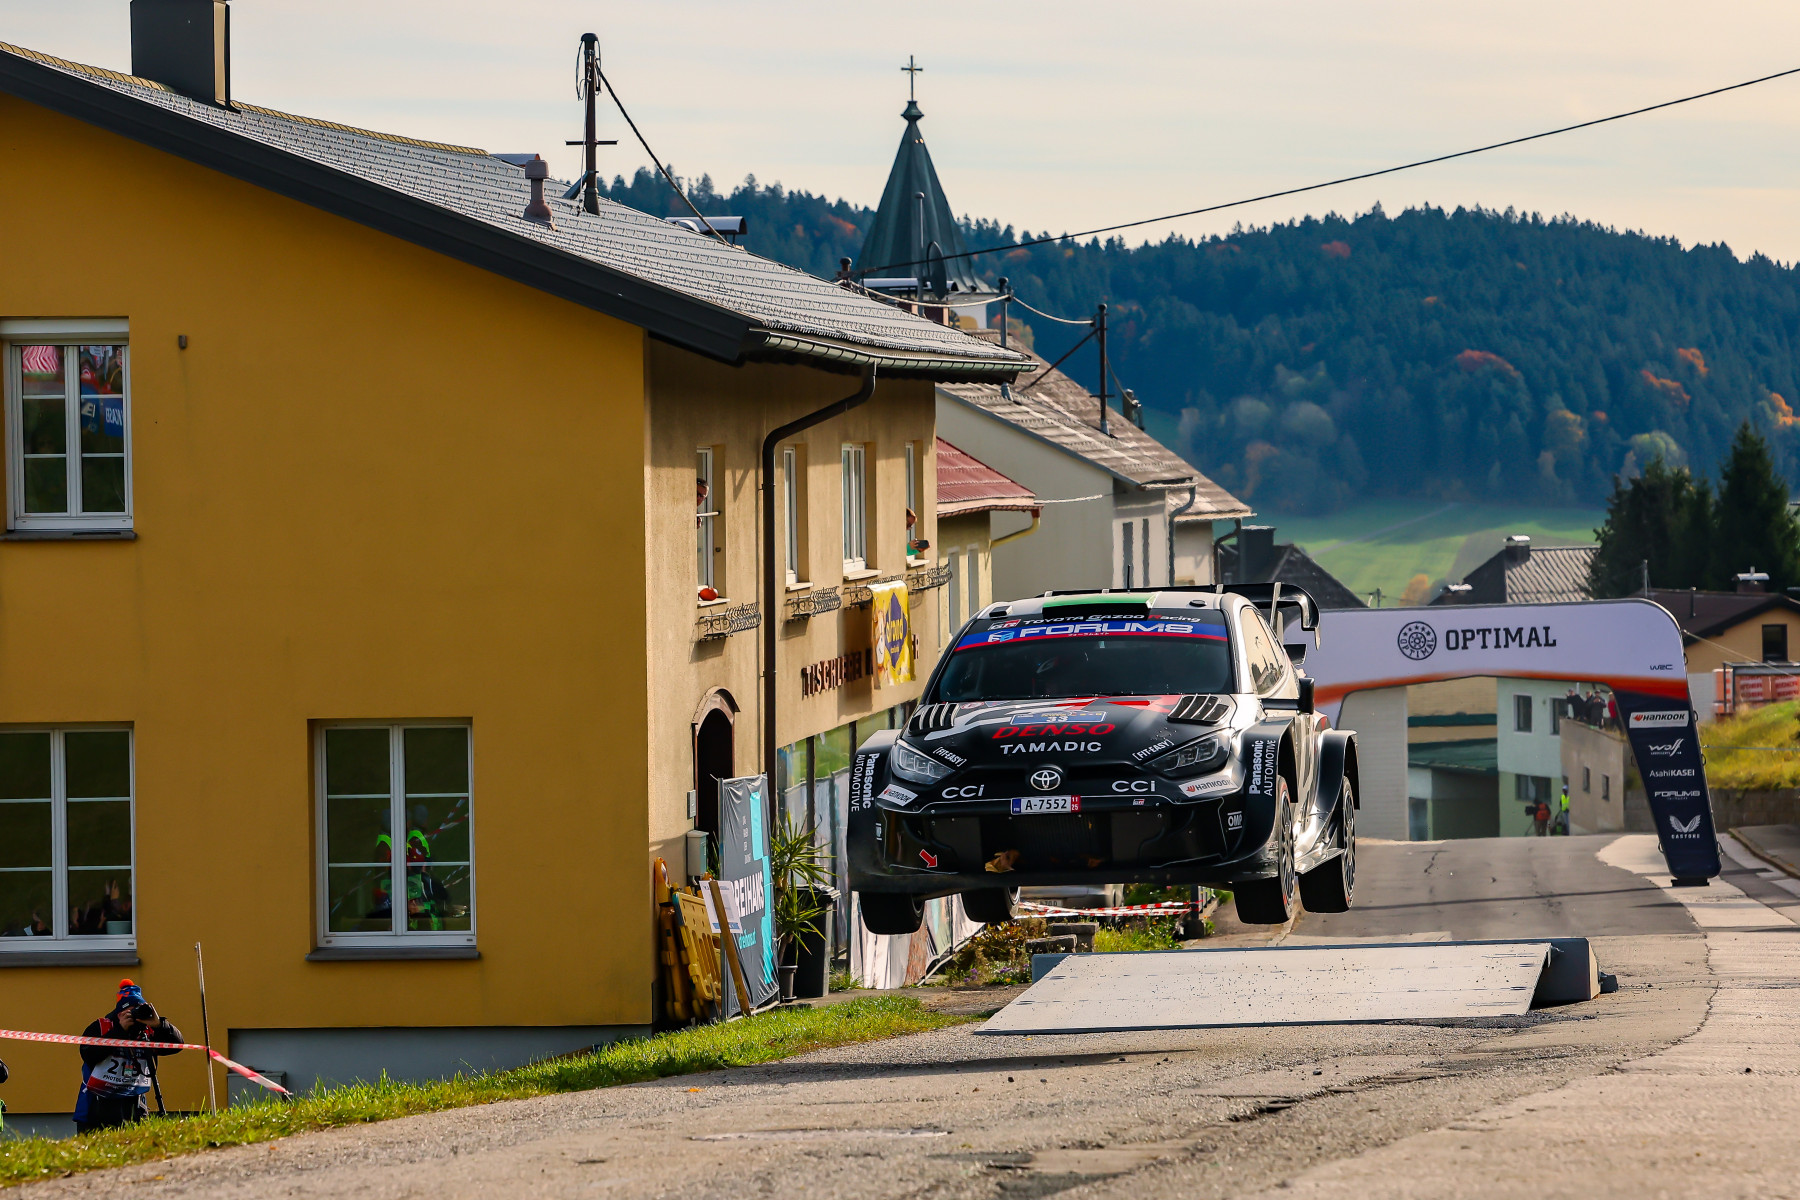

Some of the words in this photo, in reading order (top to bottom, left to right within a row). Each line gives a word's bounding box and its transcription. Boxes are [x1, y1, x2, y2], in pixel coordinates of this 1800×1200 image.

[1023, 616, 1084, 625] TOYOTA
[1086, 614, 1145, 622] GAZOO
[1148, 614, 1201, 622] Racing
[1020, 622, 1194, 637] FORUM8
[1445, 626, 1557, 650] OPTIMAL
[992, 723, 1116, 739] DENSO
[1000, 741, 1102, 755] TAMADIC
[1249, 740, 1264, 795] Panasonic
[1263, 739, 1277, 797] AUTOMOTIVE
[851, 754, 866, 812] AUTOMOTIVE
[862, 752, 881, 809] Panasonic
[1024, 798, 1067, 811] A-7552
[1227, 816, 1243, 826] OMP
